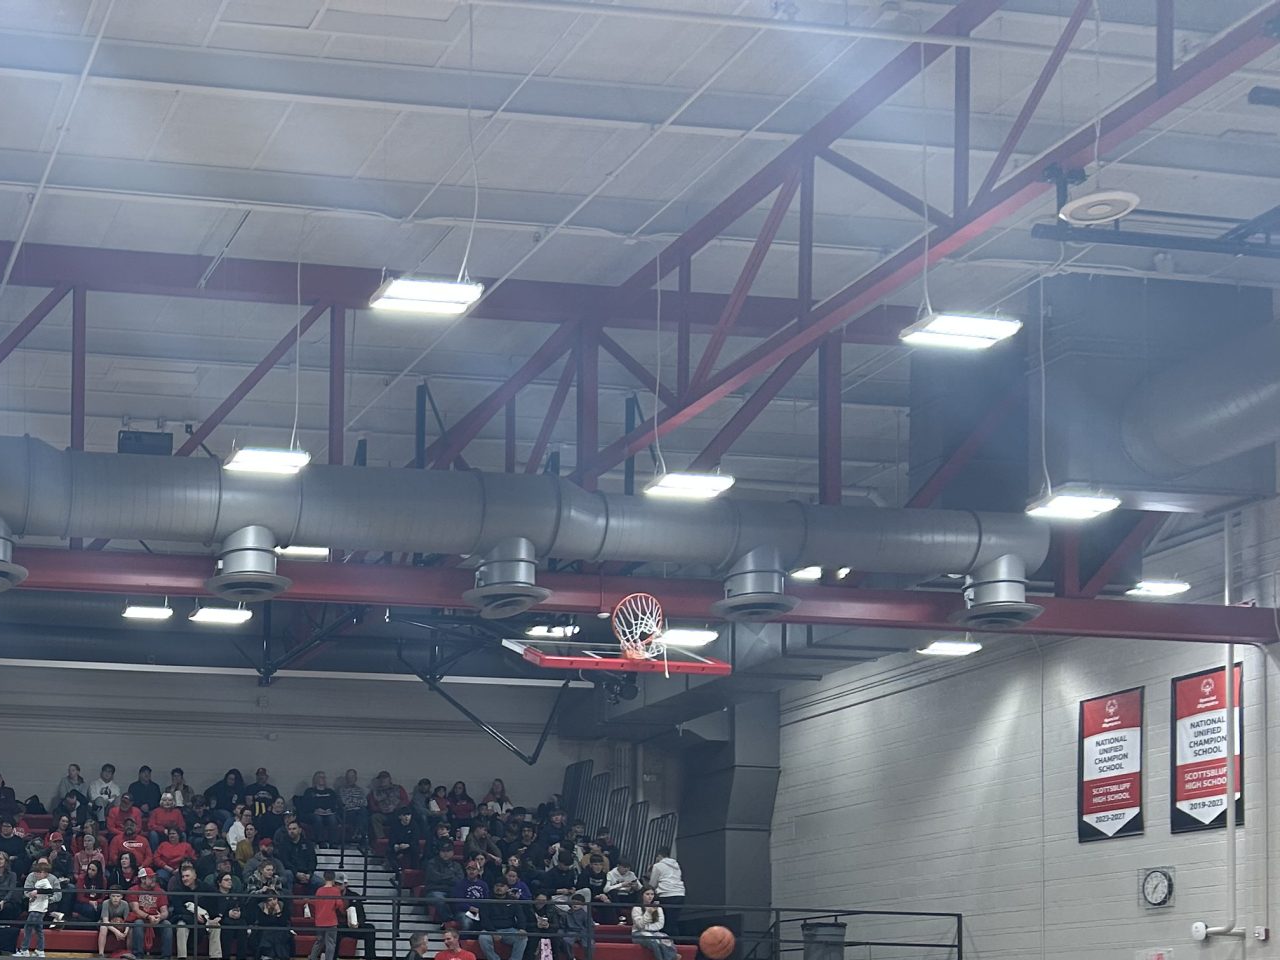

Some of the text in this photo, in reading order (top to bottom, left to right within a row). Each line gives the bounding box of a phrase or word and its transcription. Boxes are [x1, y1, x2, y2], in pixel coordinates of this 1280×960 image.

[1190, 716, 1226, 729] NATIONAL
[1193, 726, 1222, 738] UNIFIED
[1095, 735, 1128, 747] NATIONAL
[1189, 735, 1227, 749] CHAMPION
[1098, 745, 1124, 756] UNIFIED
[1193, 746, 1222, 757] SCHOOL
[1094, 753, 1129, 765] CHAMPION
[1098, 762, 1124, 774] SCHOOL
[1184, 767, 1228, 781] SCOTTSBLUF
[1092, 782, 1131, 795] SCOTTSBLUFF
[1185, 777, 1228, 790] HIGH SCHOO
[1107, 792, 1131, 802] SCHOOL
